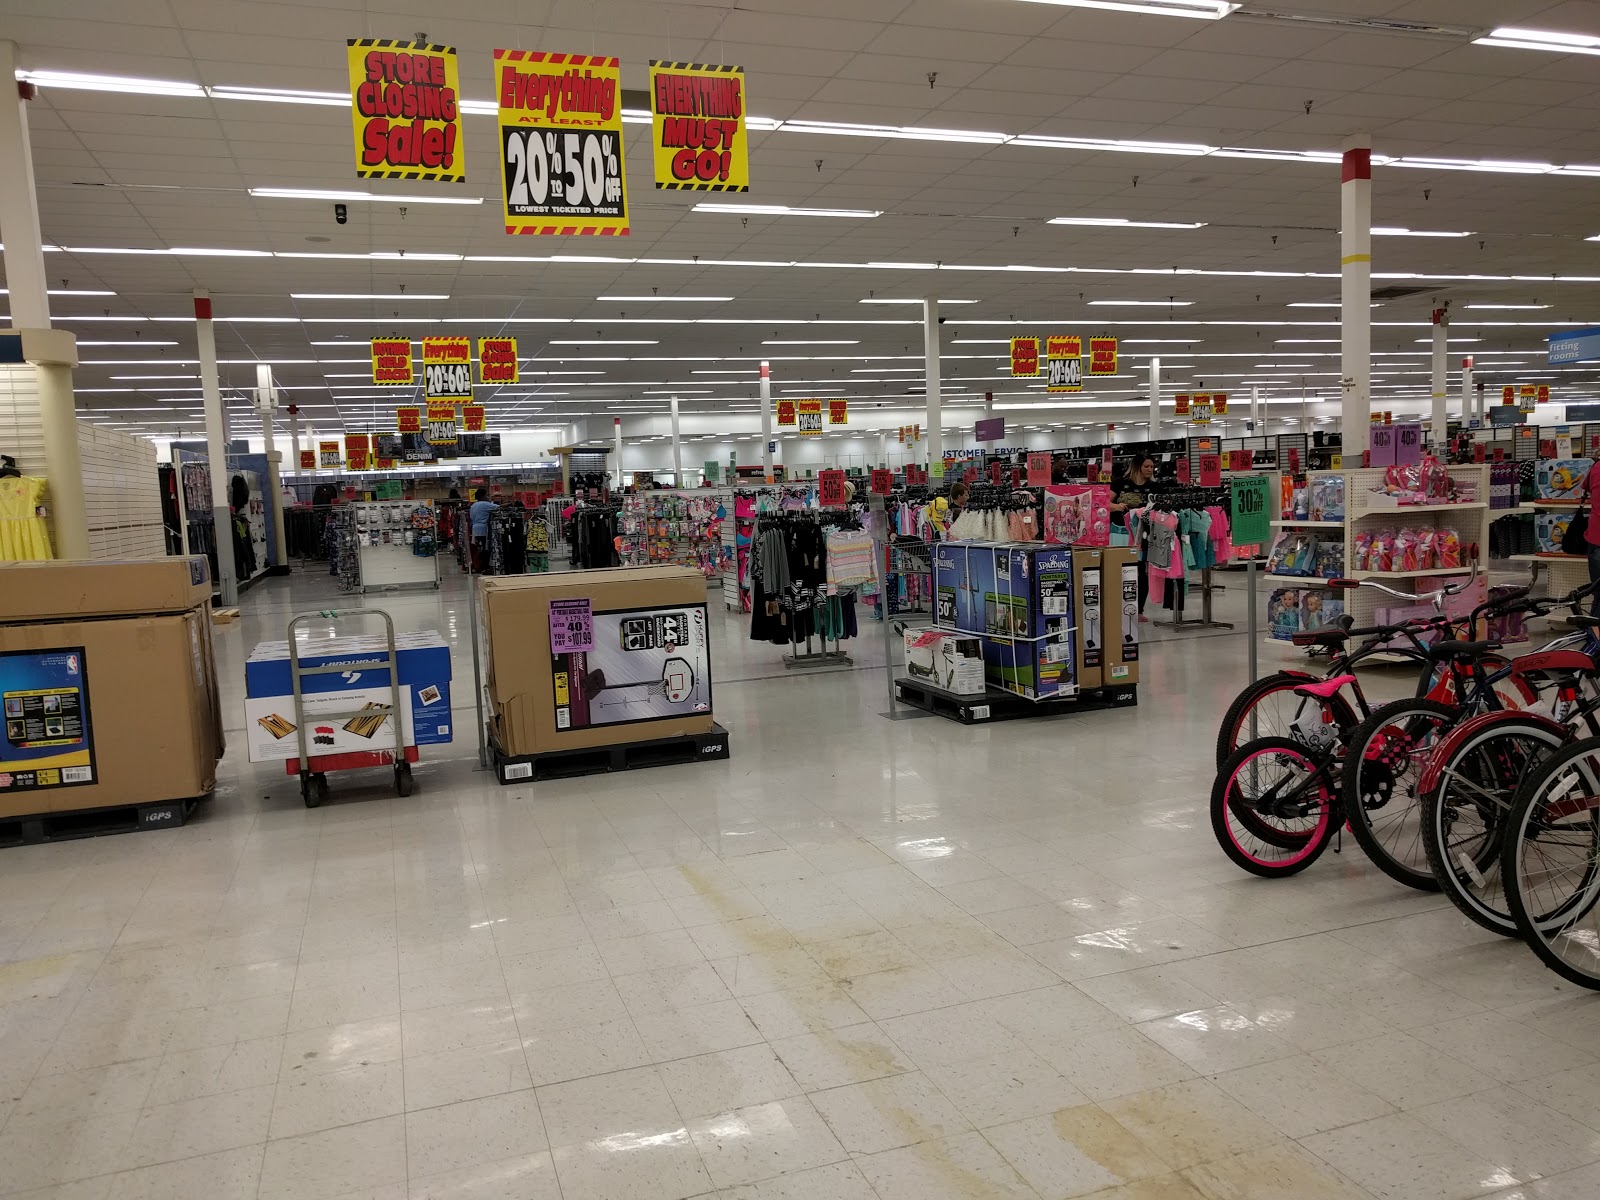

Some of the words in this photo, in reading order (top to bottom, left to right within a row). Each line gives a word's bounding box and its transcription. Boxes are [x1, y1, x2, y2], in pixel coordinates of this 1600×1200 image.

[365, 51, 445, 87] STORE
[500, 65, 616, 120] Everything
[654, 73, 741, 119] EVERYTHING
[357, 81, 456, 122] CLOSING
[550, 118, 605, 126] LEAST
[662, 117, 738, 150] MUST
[362, 117, 457, 170] Sale!
[671, 148, 731, 182] GO!
[550, 180, 563, 194] TO
[605, 177, 621, 203] OFF
[551, 206, 591, 214] TICKETED
[424, 342, 468, 361] Everything
[484, 341, 512, 353] STORE
[1048, 341, 1080, 356] Everything
[1550, 342, 1579, 351] fitting
[482, 351, 516, 364] CLOSING
[1550, 352, 1579, 360] rooms
[376, 368, 410, 381] BACK!
[483, 363, 515, 380] Sale!
[942, 449, 986, 458] USTOMER
[1233, 479, 1266, 487] BICYCLES
[1254, 500, 1263, 512] OFF
[1039, 560, 1068, 570] SPALDING
[567, 622, 582, 631] 40
[1117, 693, 1133, 701] iGPS
[702, 744, 722, 753] iGPS
[145, 811, 172, 822] iGPS
